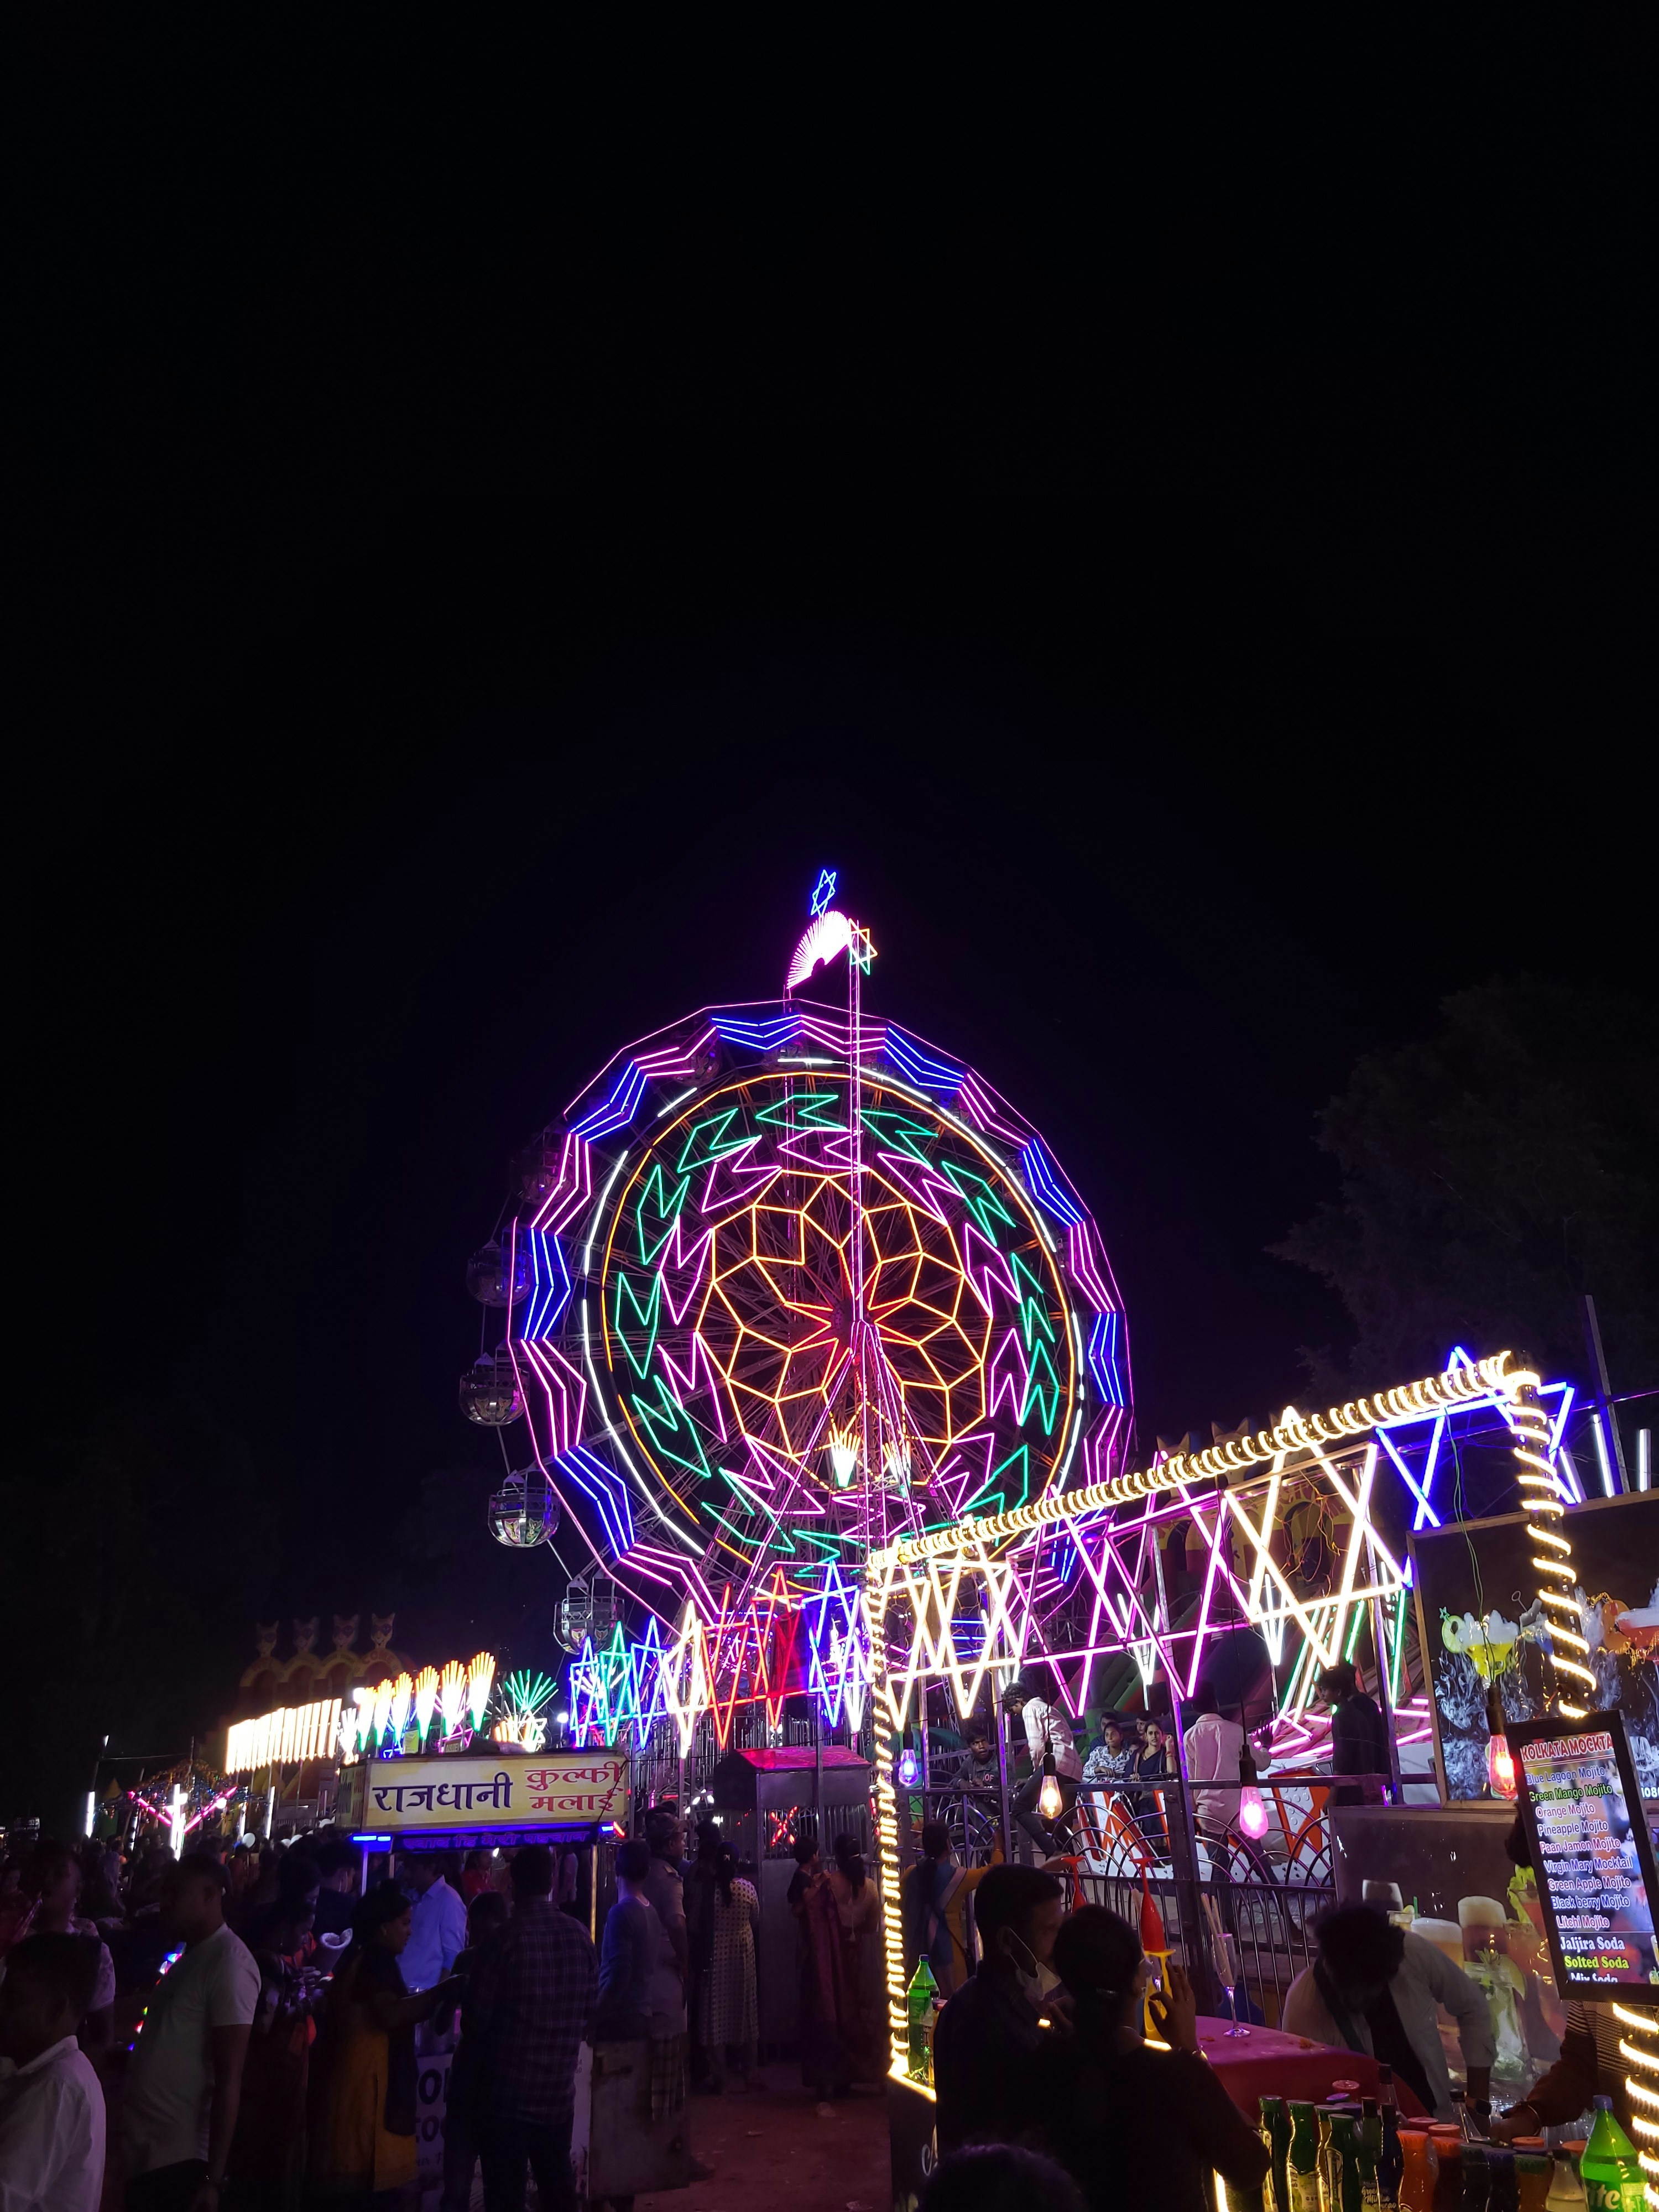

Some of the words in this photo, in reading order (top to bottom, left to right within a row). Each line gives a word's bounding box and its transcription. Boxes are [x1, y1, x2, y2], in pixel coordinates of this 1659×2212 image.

[1521, 1740, 1568, 1761] KOLKATA
[524, 1761, 622, 1791] कुल्फी
[1526, 1773, 1544, 1785] Blue
[1545, 1771, 1577, 1784] Lagoon
[1578, 1765, 1605, 1780] Mojito
[372, 1771, 513, 1812] राजधानी
[529, 1787, 624, 1812] मलाई
[1529, 1790, 1553, 1802] Green
[1554, 1787, 1583, 1799] Mango
[1584, 1783, 1613, 1798] Mojito
[1536, 1806, 1566, 1819] Orange
[1568, 1802, 1595, 1818] Mojito
[1537, 1822, 1579, 1837] Pineapple
[1581, 1819, 1608, 1834] Mojito
[1540, 1841, 1562, 1854] Paan
[1563, 1840, 1592, 1852] Jamon
[1592, 1837, 1621, 1852] Mojito
[1543, 1860, 1569, 1875] Virgin
[1571, 1859, 1593, 1873] Mary
[1594, 1856, 1632, 1870] Mocktail
[1547, 1878, 1575, 1891] Green
[1576, 1876, 1602, 1892] Apple
[1602, 1875, 1631, 1891] Mojito
[1600, 1894, 1630, 1910] Mojito
[1556, 1915, 1581, 1928] Litchi
[1582, 1915, 1610, 1931] Mojito
[1561, 1937, 1595, 1953] Jaljira
[1597, 1936, 1625, 1950] Soda
[1564, 1955, 1599, 1969] Solted
[1601, 1956, 1629, 1969] Soda
